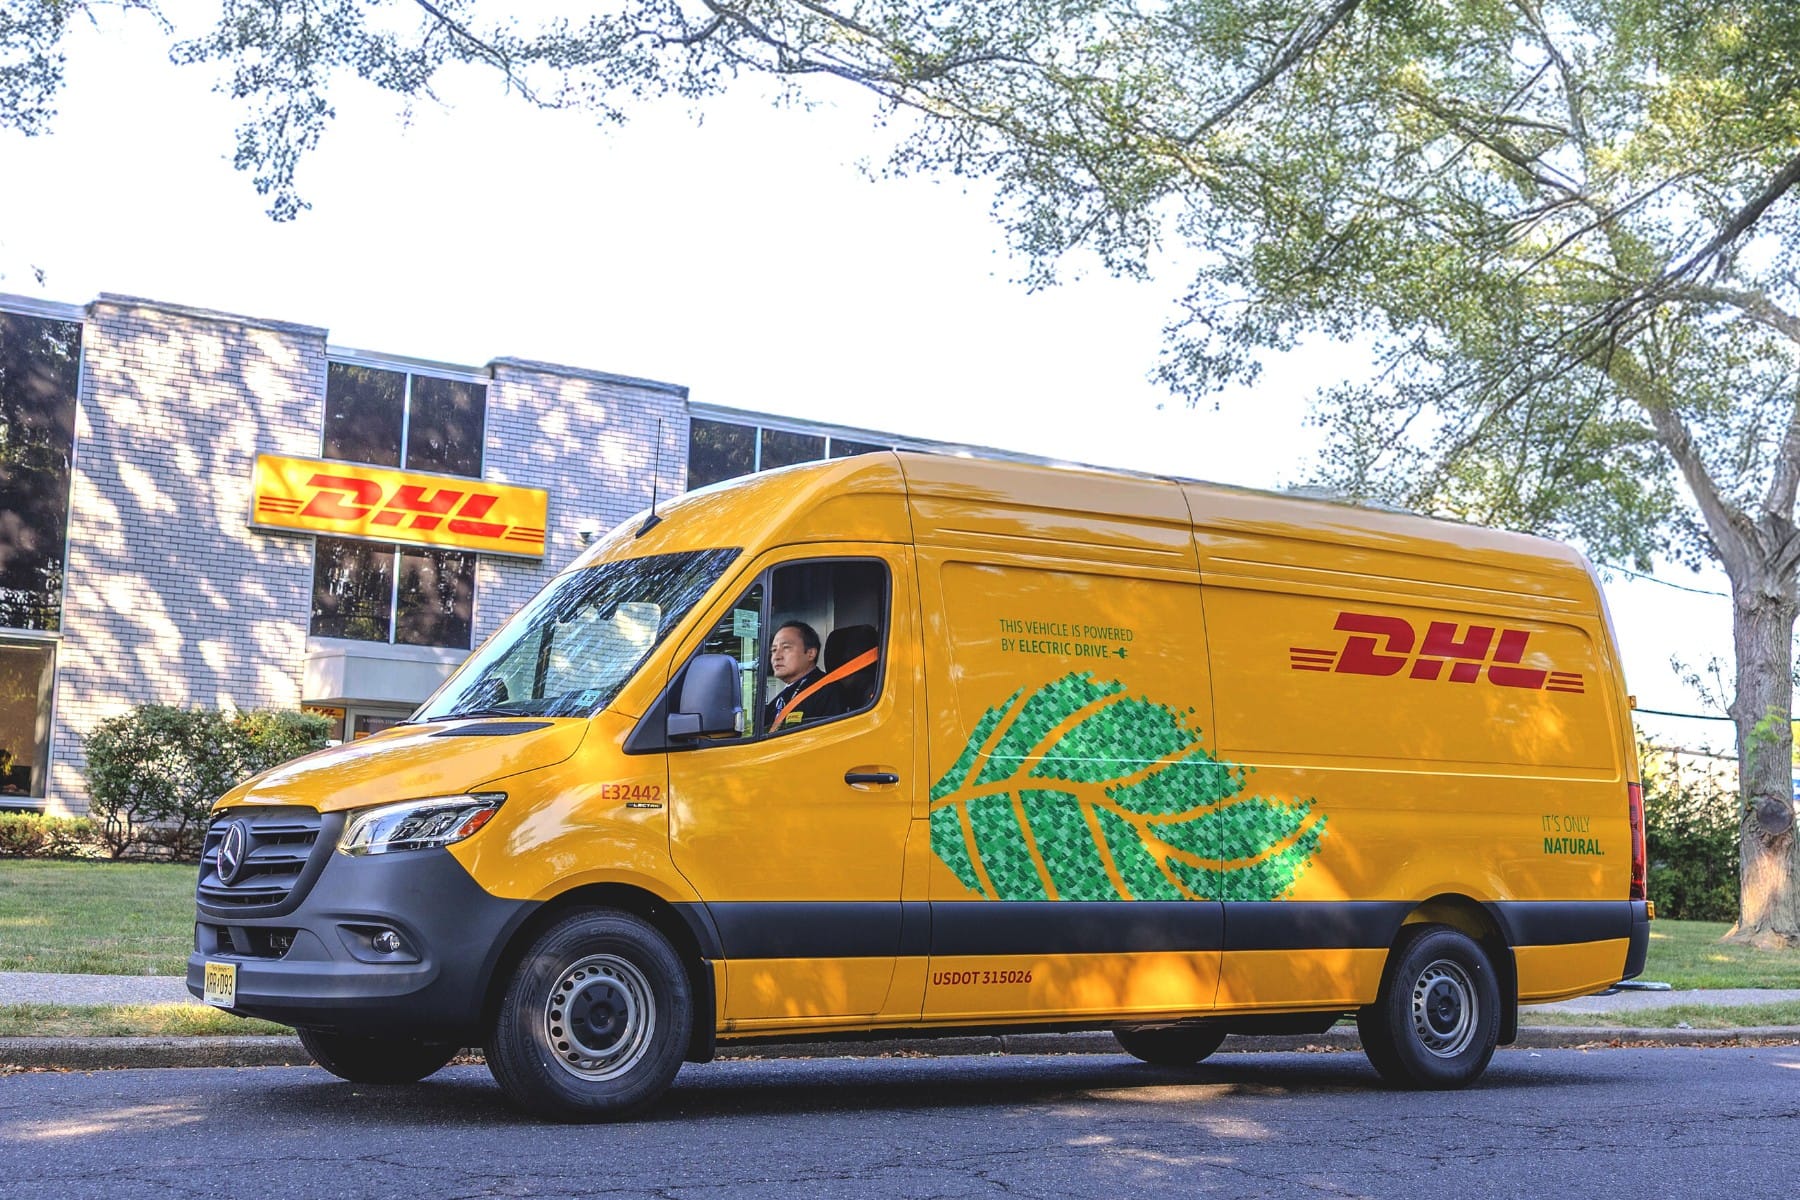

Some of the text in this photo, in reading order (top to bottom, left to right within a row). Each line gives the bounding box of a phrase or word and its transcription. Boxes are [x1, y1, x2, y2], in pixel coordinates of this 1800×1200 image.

[299, 473, 509, 539] DHL
[999, 619, 1134, 642] THIS VEHICLE IS POWERED
[1001, 638, 1112, 659] BY ELECTRIC DRIVE.
[1333, 611, 1548, 690] DHL
[601, 784, 661, 801] E32442
[1542, 814, 1590, 833] IT'S ONLY
[1543, 837, 1605, 856] NATURAL.
[933, 970, 1033, 986] USDOT 315026
